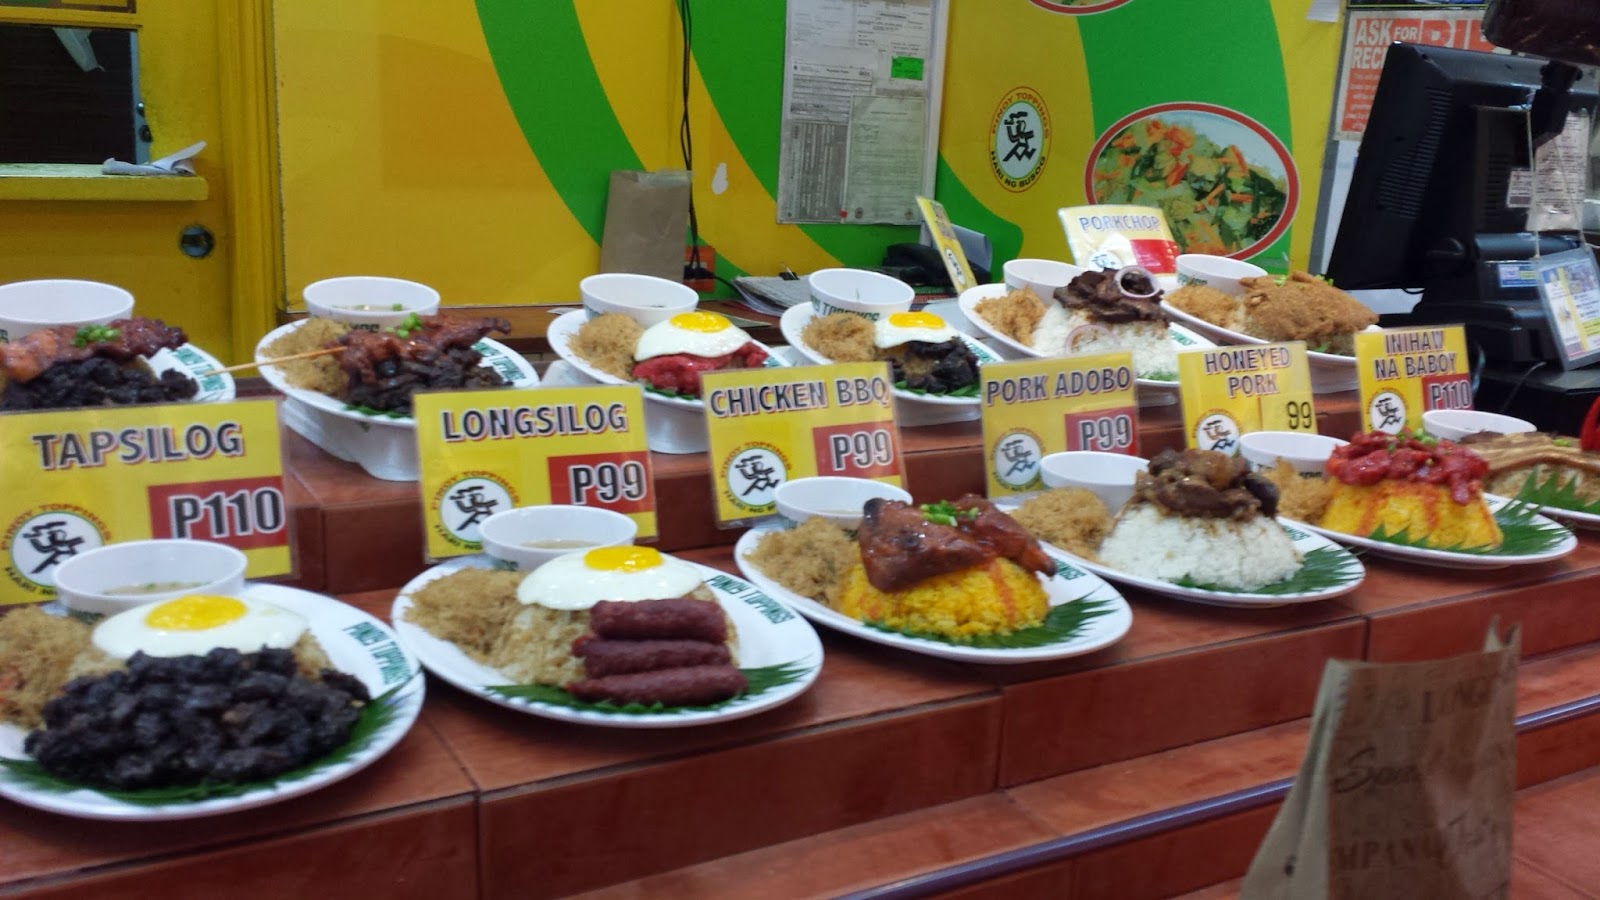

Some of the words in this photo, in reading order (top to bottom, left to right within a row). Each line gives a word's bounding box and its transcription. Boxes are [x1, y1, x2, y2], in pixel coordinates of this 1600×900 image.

[1354, 19, 1394, 46] ASK
[1394, 26, 1419, 41] FOR
[1078, 214, 1161, 232] PORKCHOP
[1385, 330, 1445, 355] INIHAW
[1205, 346, 1291, 375] HONEYED
[1375, 358, 1400, 381] NA
[1405, 352, 1457, 378] BABOY
[710, 381, 829, 418] CHICKEN
[835, 376, 890, 408] BBQ
[986, 373, 1049, 406] PORK
[1054, 365, 1132, 398] ADOBO
[1228, 373, 1280, 398] PORK
[1430, 380, 1472, 410] P110
[441, 401, 629, 442] LONGSILOG
[1287, 401, 1312, 430] 99
[32, 421, 245, 470] TAPSILOG
[1079, 415, 1133, 451] P99
[830, 429, 893, 471] P99
[569, 461, 647, 504] P99
[169, 486, 286, 539] P110
